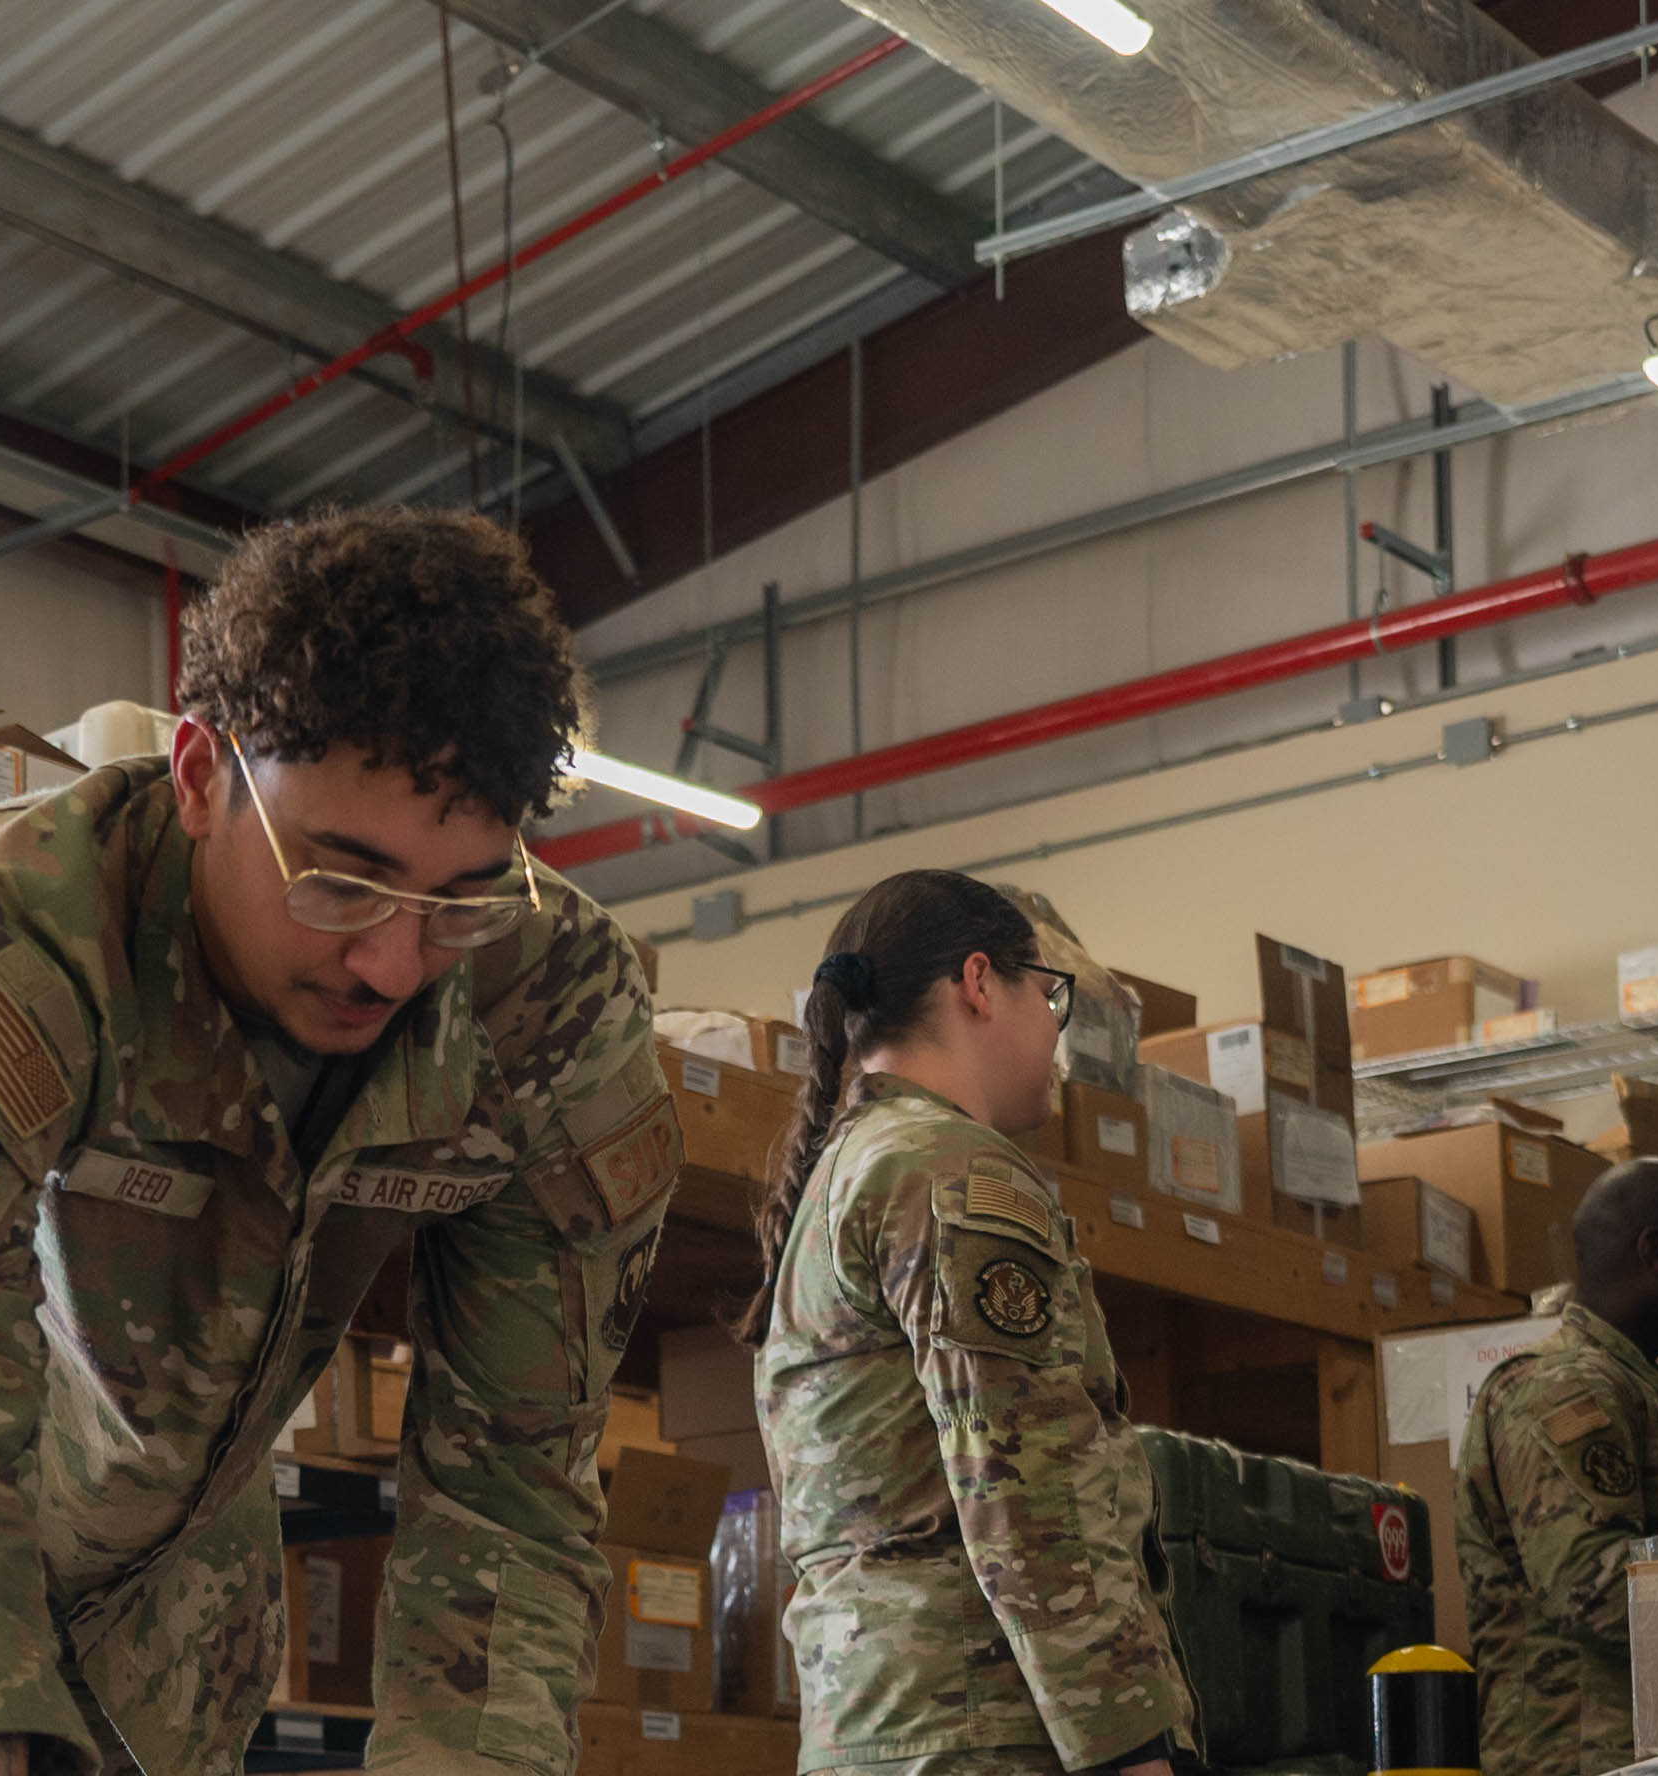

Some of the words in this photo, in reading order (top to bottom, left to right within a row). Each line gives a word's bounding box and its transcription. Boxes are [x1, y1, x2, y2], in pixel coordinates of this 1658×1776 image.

[607, 1121, 672, 1200] SUP
[118, 1166, 174, 1204] REED
[371, 1178, 416, 1207] AIR
[423, 1179, 503, 1211] FORCE
